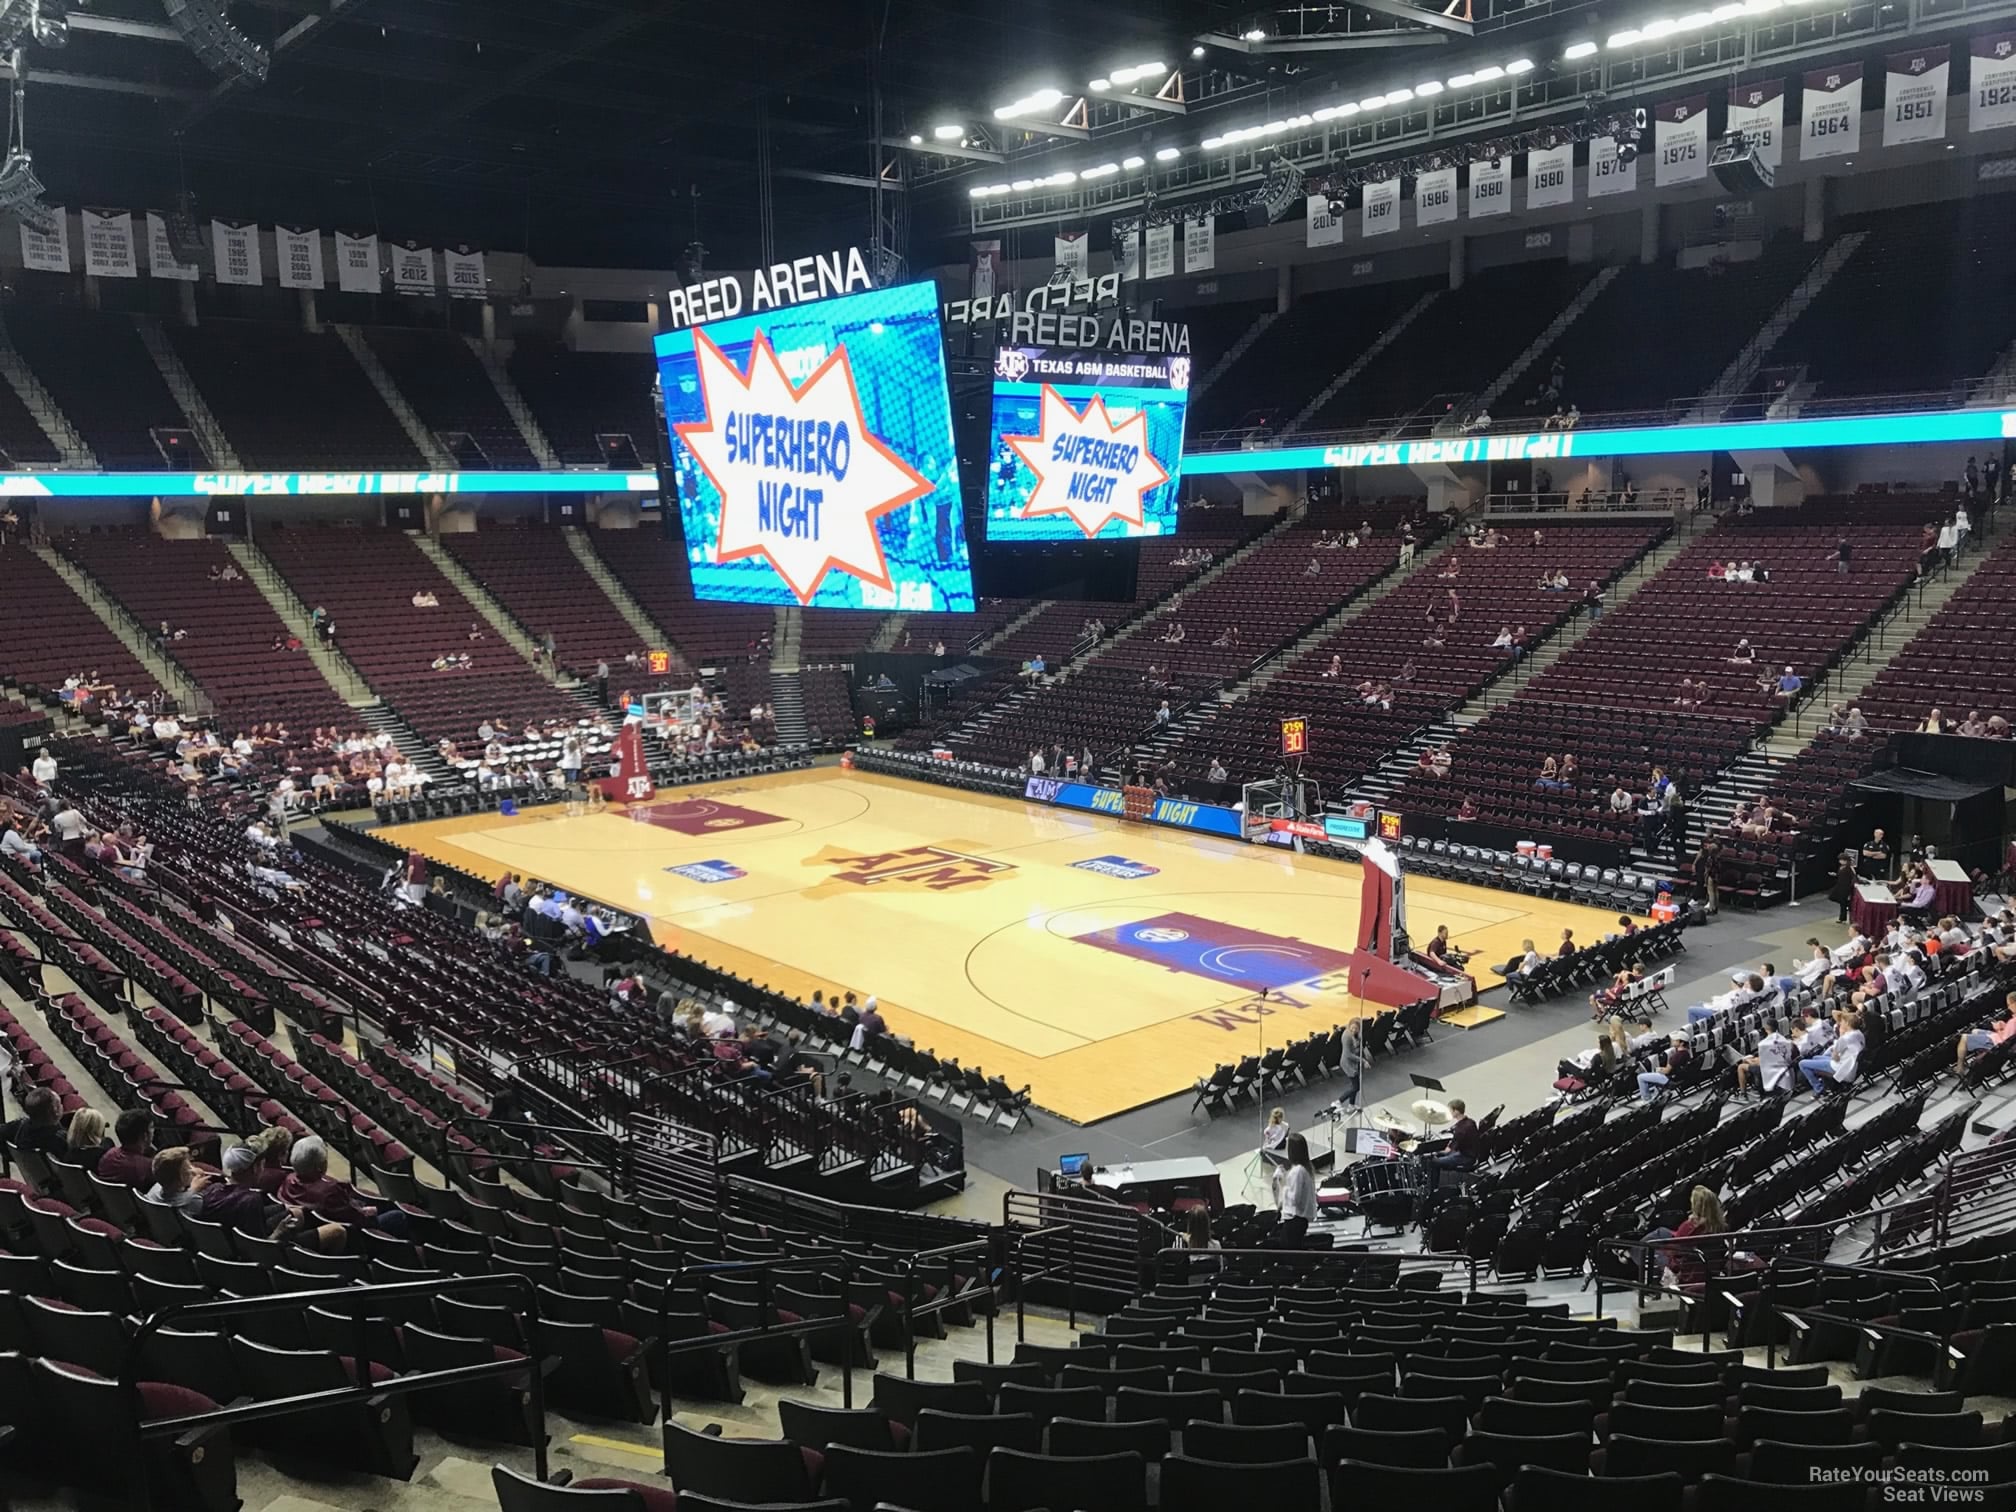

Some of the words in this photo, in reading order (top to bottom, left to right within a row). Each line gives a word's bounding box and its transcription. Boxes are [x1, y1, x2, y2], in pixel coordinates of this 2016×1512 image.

[1896, 100, 1933, 122] 1951
[1810, 115, 1849, 137] 1964
[1663, 143, 1697, 165] 1975
[1475, 181, 1503, 199] 1980
[1535, 170, 1564, 190] 1980
[1367, 201, 1392, 219] 1987
[1525, 232, 1551, 248] 220
[401, 268, 427, 280] 2012
[454, 272, 479, 284] 2015
[668, 274, 742, 328] REED
[752, 247, 872, 310] ARENA
[1011, 312, 1100, 348] REED
[1107, 318, 1191, 354] ARENA
[1032, 359, 1074, 375] TEXAS
[1075, 360, 1102, 376] A&M
[1105, 362, 1168, 379] BASKETBALL
[725, 410, 851, 483] SUPERHERO
[1052, 432, 1139, 475] SUPERHERO
[1067, 471, 1118, 505] NIGHT
[758, 480, 823, 542] NIGHT
[1286, 732, 1302, 752] 30
[1157, 802, 1199, 825] NIGHT
[1384, 825, 1396, 836] 30
